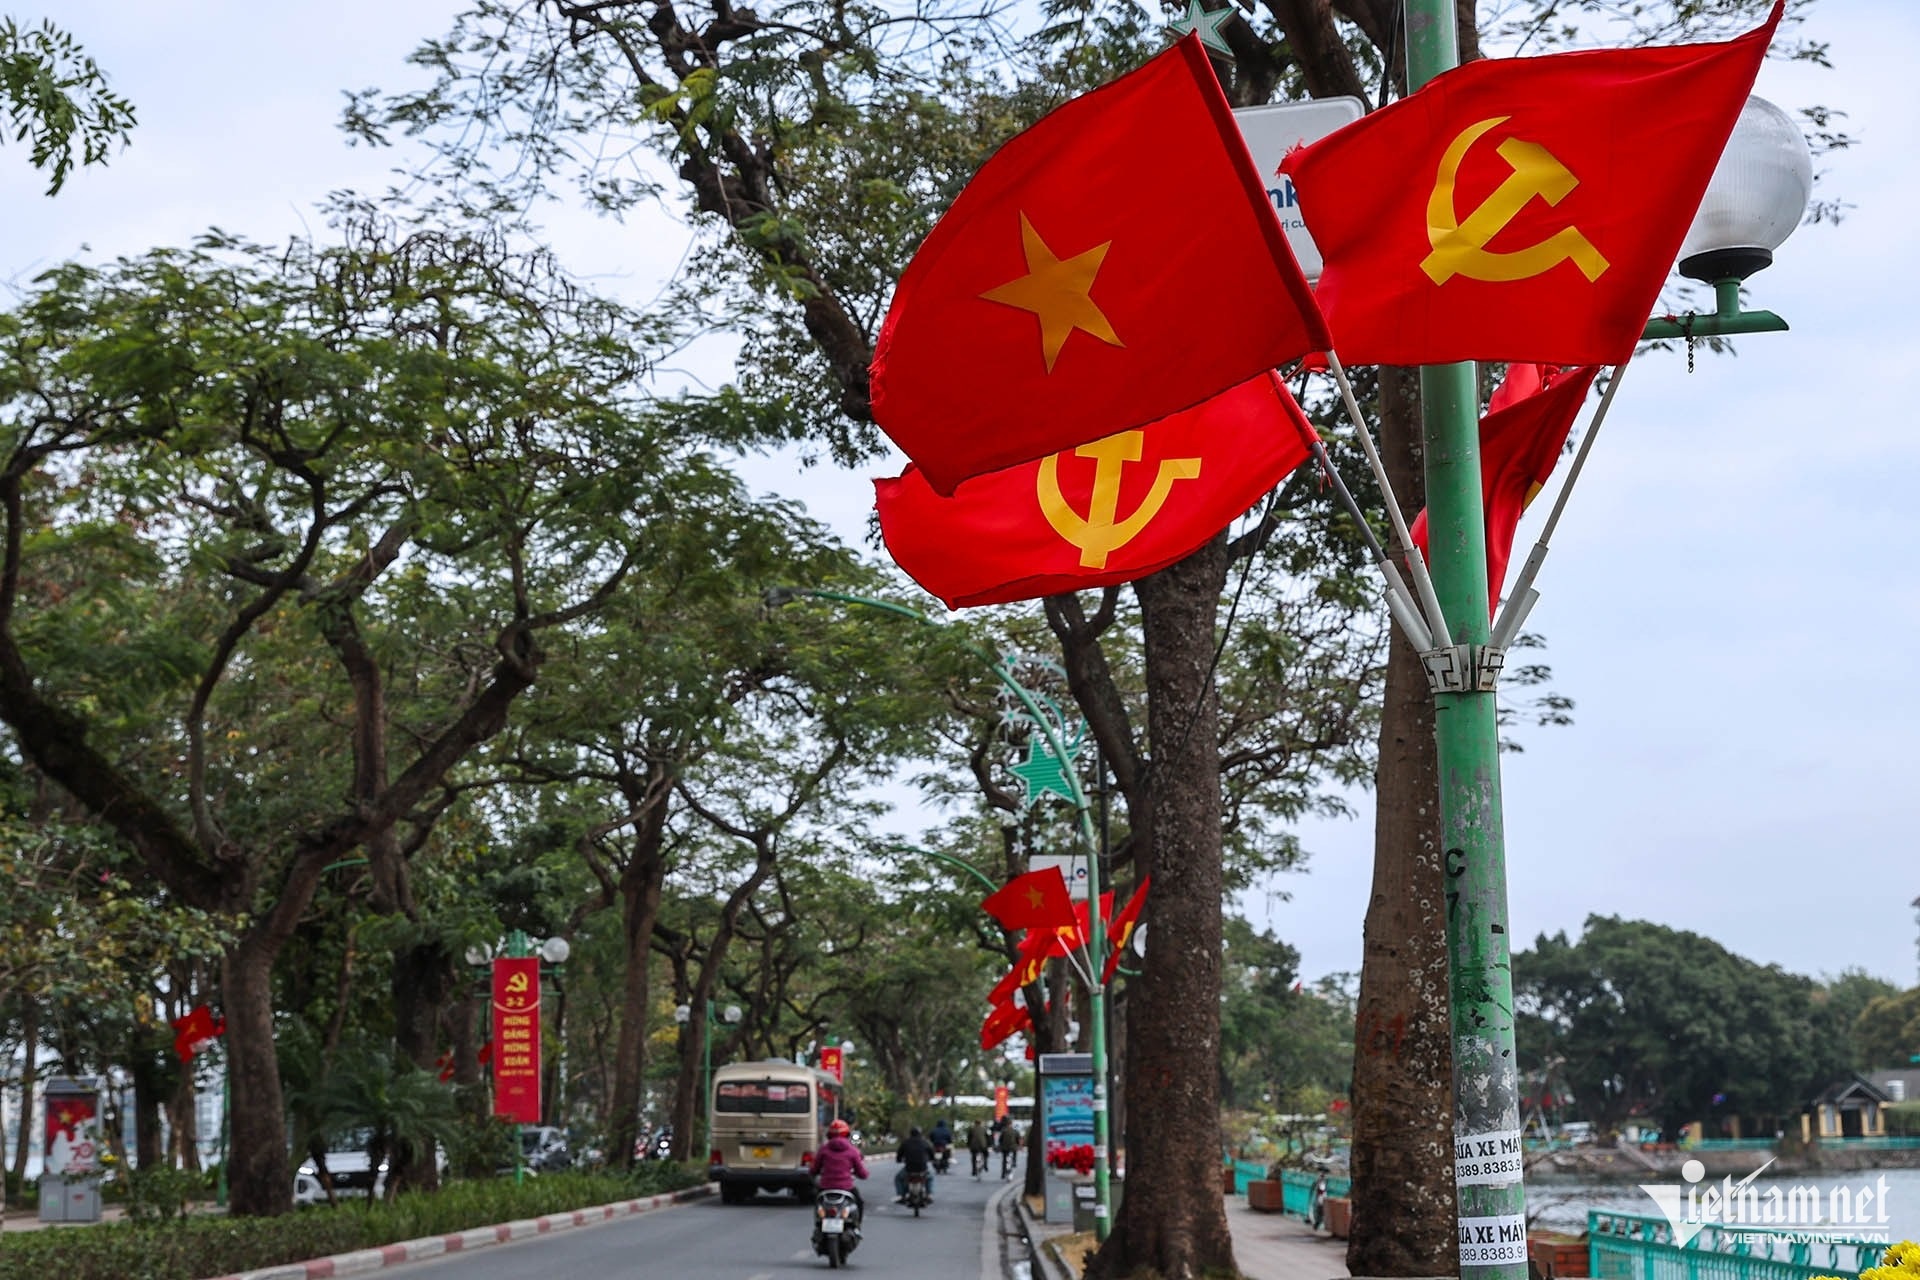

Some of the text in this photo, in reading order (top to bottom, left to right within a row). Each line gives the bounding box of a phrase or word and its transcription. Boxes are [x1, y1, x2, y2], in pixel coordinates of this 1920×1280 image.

[1476, 1140, 1497, 1157] XE
[1475, 1226, 1495, 1243] XE
[1499, 1220, 1524, 1243] MÁY
